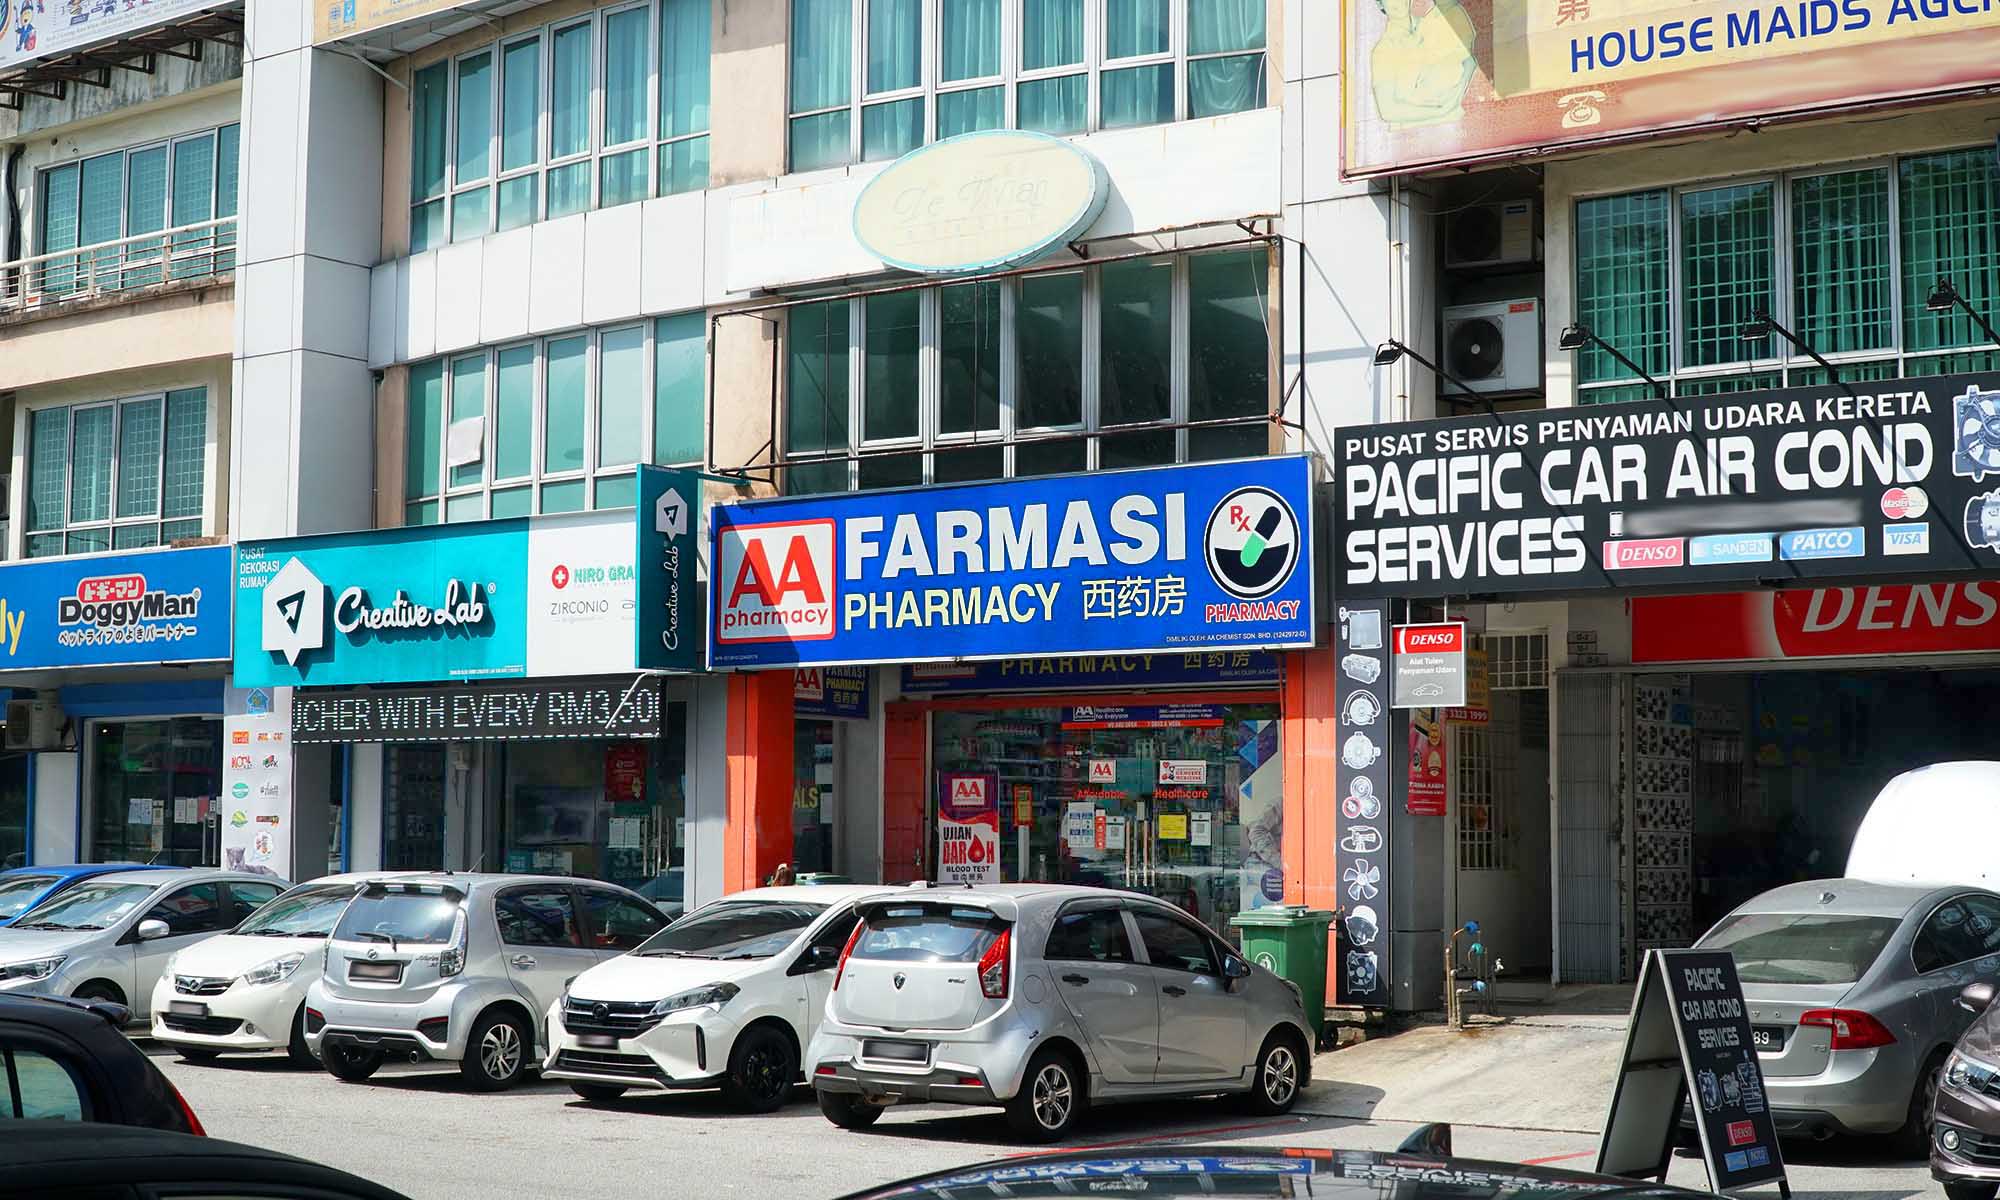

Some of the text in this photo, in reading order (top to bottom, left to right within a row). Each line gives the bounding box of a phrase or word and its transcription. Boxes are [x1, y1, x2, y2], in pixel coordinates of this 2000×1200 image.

[1570, 17, 1713, 73] HOUSE
[1726, 0, 1871, 49] MAIDS
[1346, 391, 1931, 460] PUSAT SERVIS PENYAMAN UDARA KERETA
[1346, 422, 1934, 521] PACIFIC CAR AIR COND
[845, 492, 1186, 581] FARMASI
[1791, 531, 1853, 552] PATCO
[1890, 533, 1921, 545] VISA
[240, 547, 265, 560] PUSAT
[1346, 515, 1587, 585] SERVICES
[1621, 544, 1678, 562] DENSO
[1712, 541, 1766, 557] SANDEN
[240, 560, 280, 575] DEKORASI
[574, 567, 604, 583] NIRO
[728, 535, 826, 609] AA
[240, 576, 267, 589] RUMAH
[334, 586, 432, 633] Creative
[551, 599, 609, 616] ZIRCONIO
[845, 574, 1188, 631] PHARMACY 西药房
[1205, 600, 1300, 623] PHARMACY
[663, 582, 679, 651] Creative
[724, 607, 829, 630] pharmacy
[1410, 633, 1454, 646] DENSO
[1001, 654, 1154, 676] PHARMACY
[794, 667, 821, 690] AA
[378, 695, 445, 730] WITH
[453, 693, 539, 727] EVERY
[1093, 763, 1112, 776] AA
[955, 781, 982, 797] AA
[943, 826, 972, 841] UJIAN
[946, 865, 990, 873] BLOOD TEST
[1684, 967, 1726, 992] PACIFIC
[1682, 998, 1742, 1022] CAR AIR COND
[1698, 1026, 1740, 1049] SERVICES
